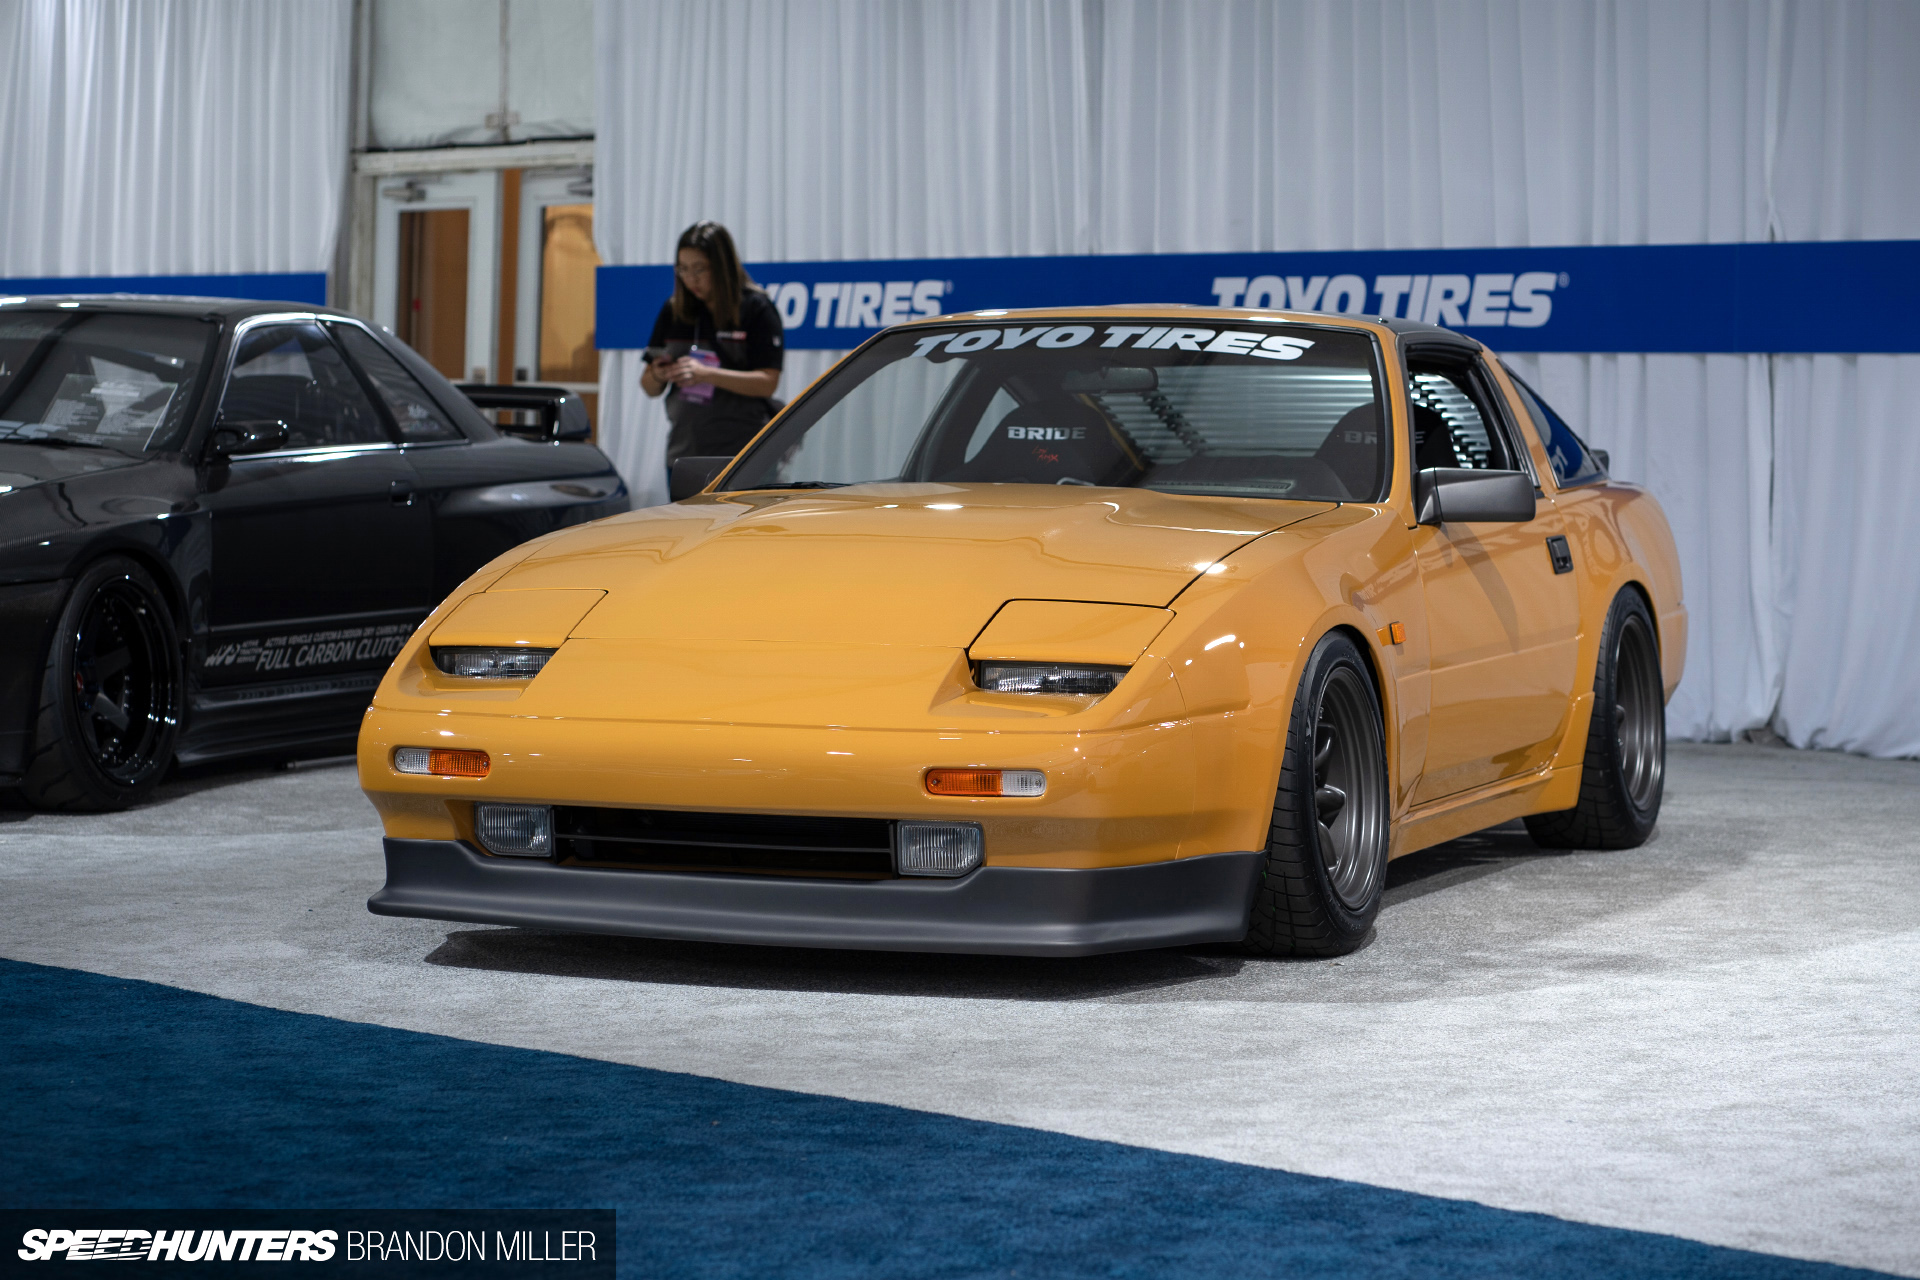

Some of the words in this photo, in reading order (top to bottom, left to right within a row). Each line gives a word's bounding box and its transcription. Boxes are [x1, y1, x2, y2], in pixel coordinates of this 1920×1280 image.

[811, 280, 945, 329] TIRES
[1211, 274, 1366, 314] TOYO
[1373, 272, 1557, 328] TIRES
[912, 325, 1095, 358] TOYO
[1100, 325, 1316, 361] TIRES
[1007, 426, 1087, 441] BRIDE
[1343, 430, 1426, 444] BRE
[256, 646, 292, 672] FULL
[295, 640, 357, 667] CARBON
